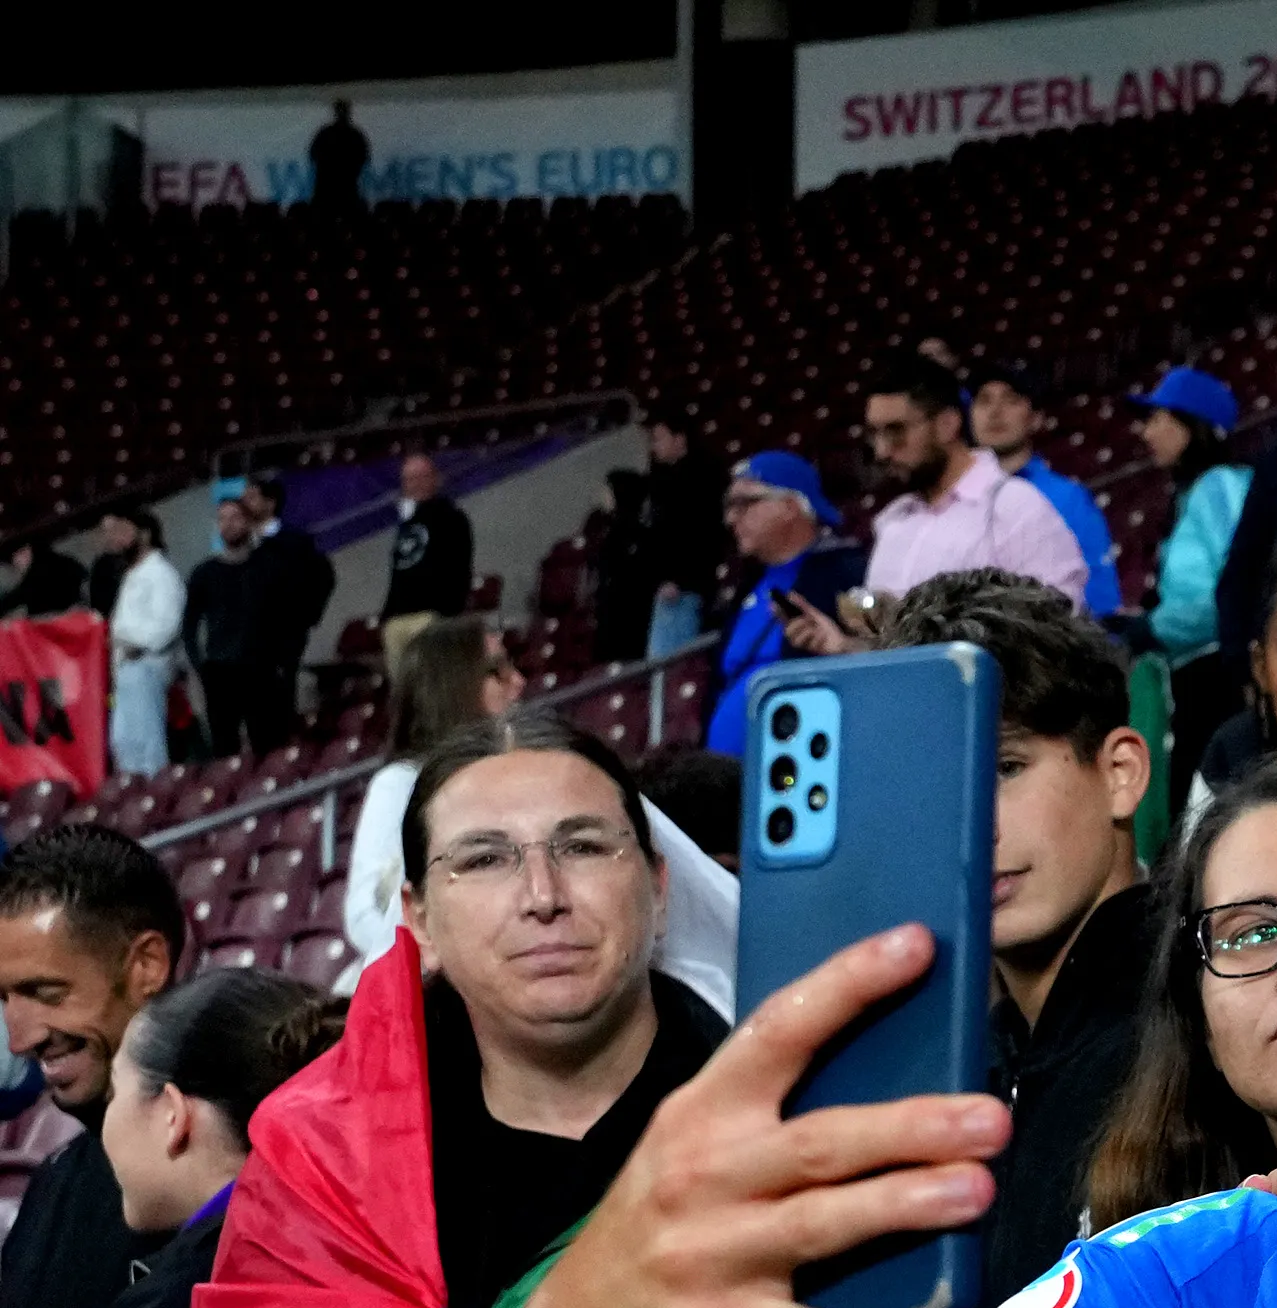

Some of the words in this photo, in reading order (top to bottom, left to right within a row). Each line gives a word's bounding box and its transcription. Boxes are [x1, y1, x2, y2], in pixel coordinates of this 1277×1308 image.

[843, 61, 1224, 141] SWITZERLAND
[152, 160, 251, 206] EFA
[266, 150, 517, 204] WMEN'S
[536, 145, 679, 199] EURO
